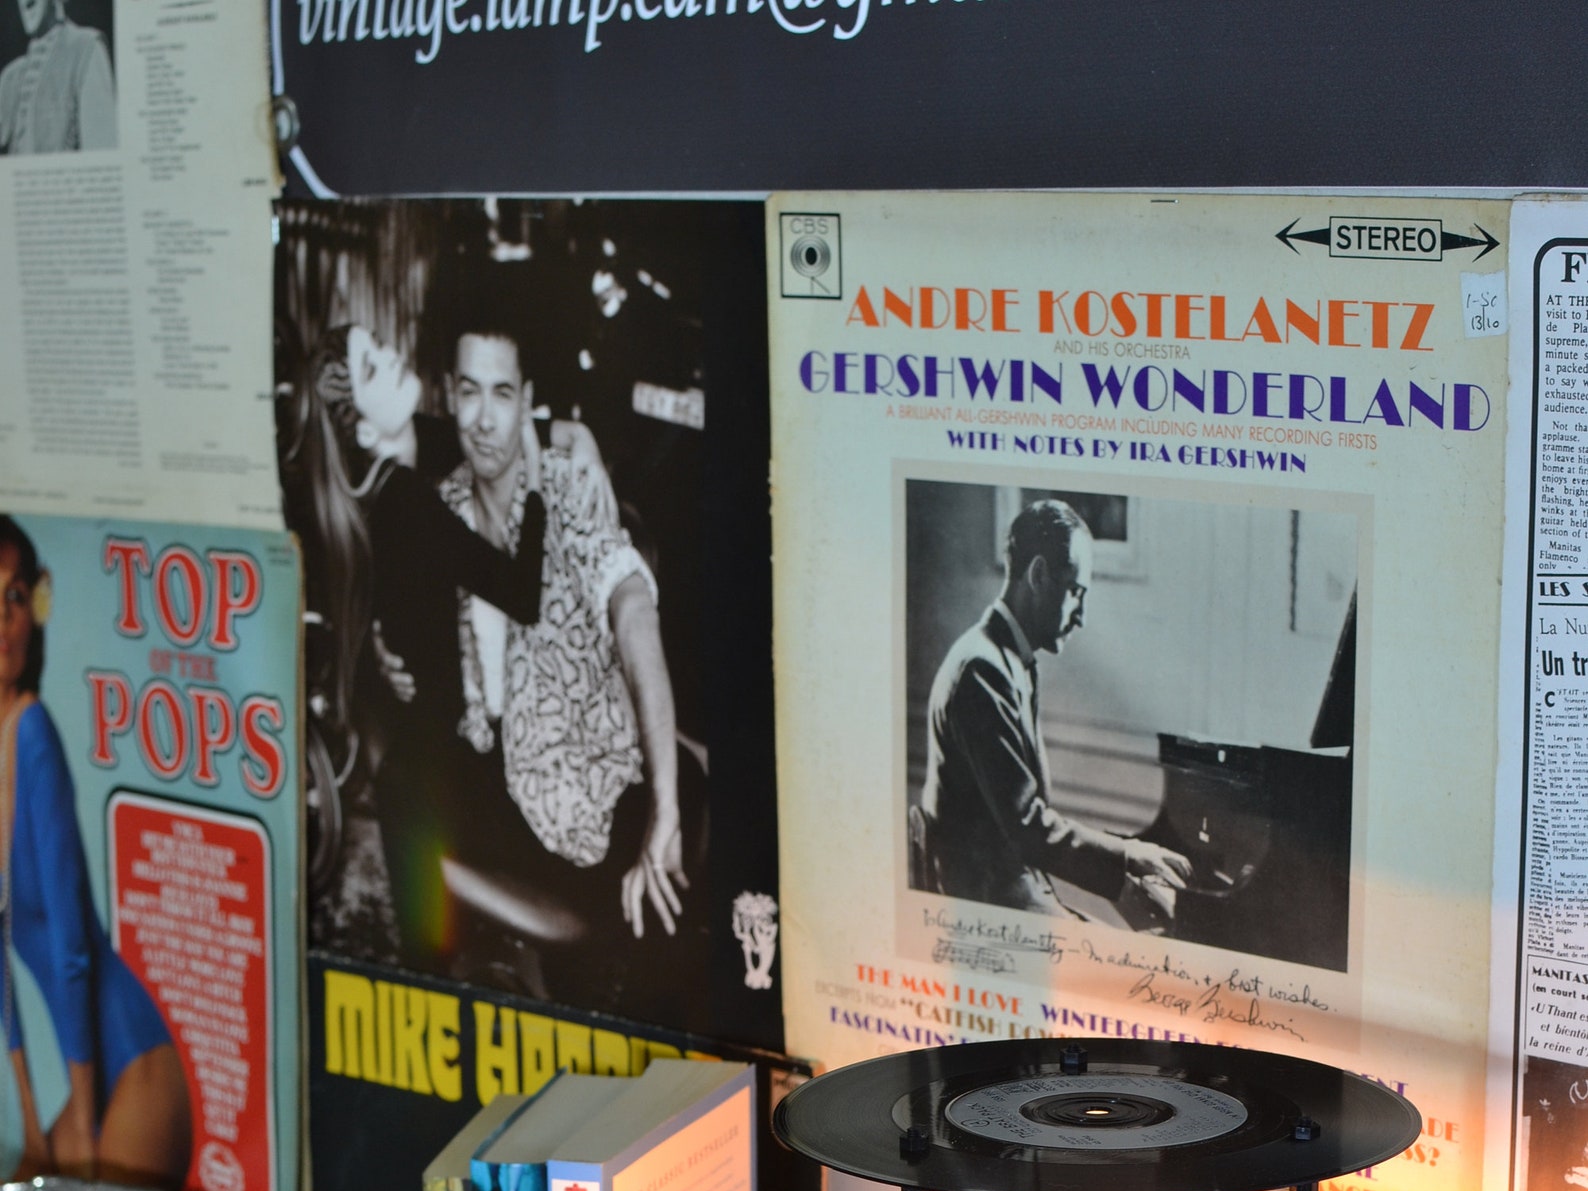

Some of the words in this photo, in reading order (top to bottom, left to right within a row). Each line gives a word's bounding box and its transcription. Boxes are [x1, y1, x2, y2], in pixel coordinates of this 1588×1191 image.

[790, 217, 829, 235] CBS
[1335, 225, 1437, 253] STEREO
[1546, 294, 1562, 306] AT
[845, 284, 1021, 333] ANDRE
[1038, 289, 1435, 352] KOSTELANETZ
[1546, 309, 1567, 320] visit
[1572, 311, 1581, 320] to
[1546, 322, 1557, 332] de
[1545, 337, 1588, 348] supreme,
[1054, 340, 1083, 355] AND
[1088, 342, 1110, 357] HIS
[1114, 342, 1191, 360] ORCHESTRA
[1545, 349, 1578, 360] minute
[1545, 364, 1550, 372] a
[1546, 377, 1555, 386] to
[1561, 378, 1576, 389] say
[799, 350, 1064, 405] GERSHWIN
[1080, 363, 1491, 432] WONDERLAND
[1544, 402, 1588, 414] audience.
[900, 406, 952, 421] BRILLIANT
[955, 409, 1047, 427] ALL-GERSHWIN
[1050, 414, 1117, 432] PROGRAM
[1121, 418, 1198, 438] INCLUDING
[1202, 424, 1244, 440] MANY
[1249, 426, 1333, 447] RECORDING
[1338, 432, 1378, 451] FIRSTS
[1553, 421, 1568, 431] Not
[1542, 433, 1580, 442] applause.
[947, 430, 1005, 452] WITH
[1014, 435, 1085, 457] NOTES
[1093, 439, 1124, 460] BY
[1130, 442, 1172, 463] IRA
[1178, 445, 1307, 474] GERSHWIN
[1542, 444, 1575, 453] gramme
[1554, 453, 1575, 463] leave
[1542, 463, 1565, 473] home
[1542, 474, 1568, 485] enjoys
[1542, 485, 1555, 494] the
[1541, 506, 1564, 516] winks
[1540, 516, 1564, 526] guitar
[1570, 518, 1588, 528] held
[1540, 527, 1569, 537] section
[1549, 540, 1582, 552] Manitas
[1540, 550, 1579, 563] Flamenco
[104, 535, 264, 655] TOP
[1540, 581, 1571, 597] LES
[1539, 618, 1557, 635] La
[1542, 650, 1564, 676] Un
[85, 666, 288, 800] POPS
[1532, 966, 1588, 985] MANITAS
[855, 964, 892, 987] THE
[901, 972, 946, 998] MAN
[968, 986, 1024, 1017] LOVE
[1551, 988, 1576, 999] court
[324, 969, 463, 1102] MIKE
[1529, 1036, 1539, 1048] la
[1543, 1041, 1572, 1055] reine
